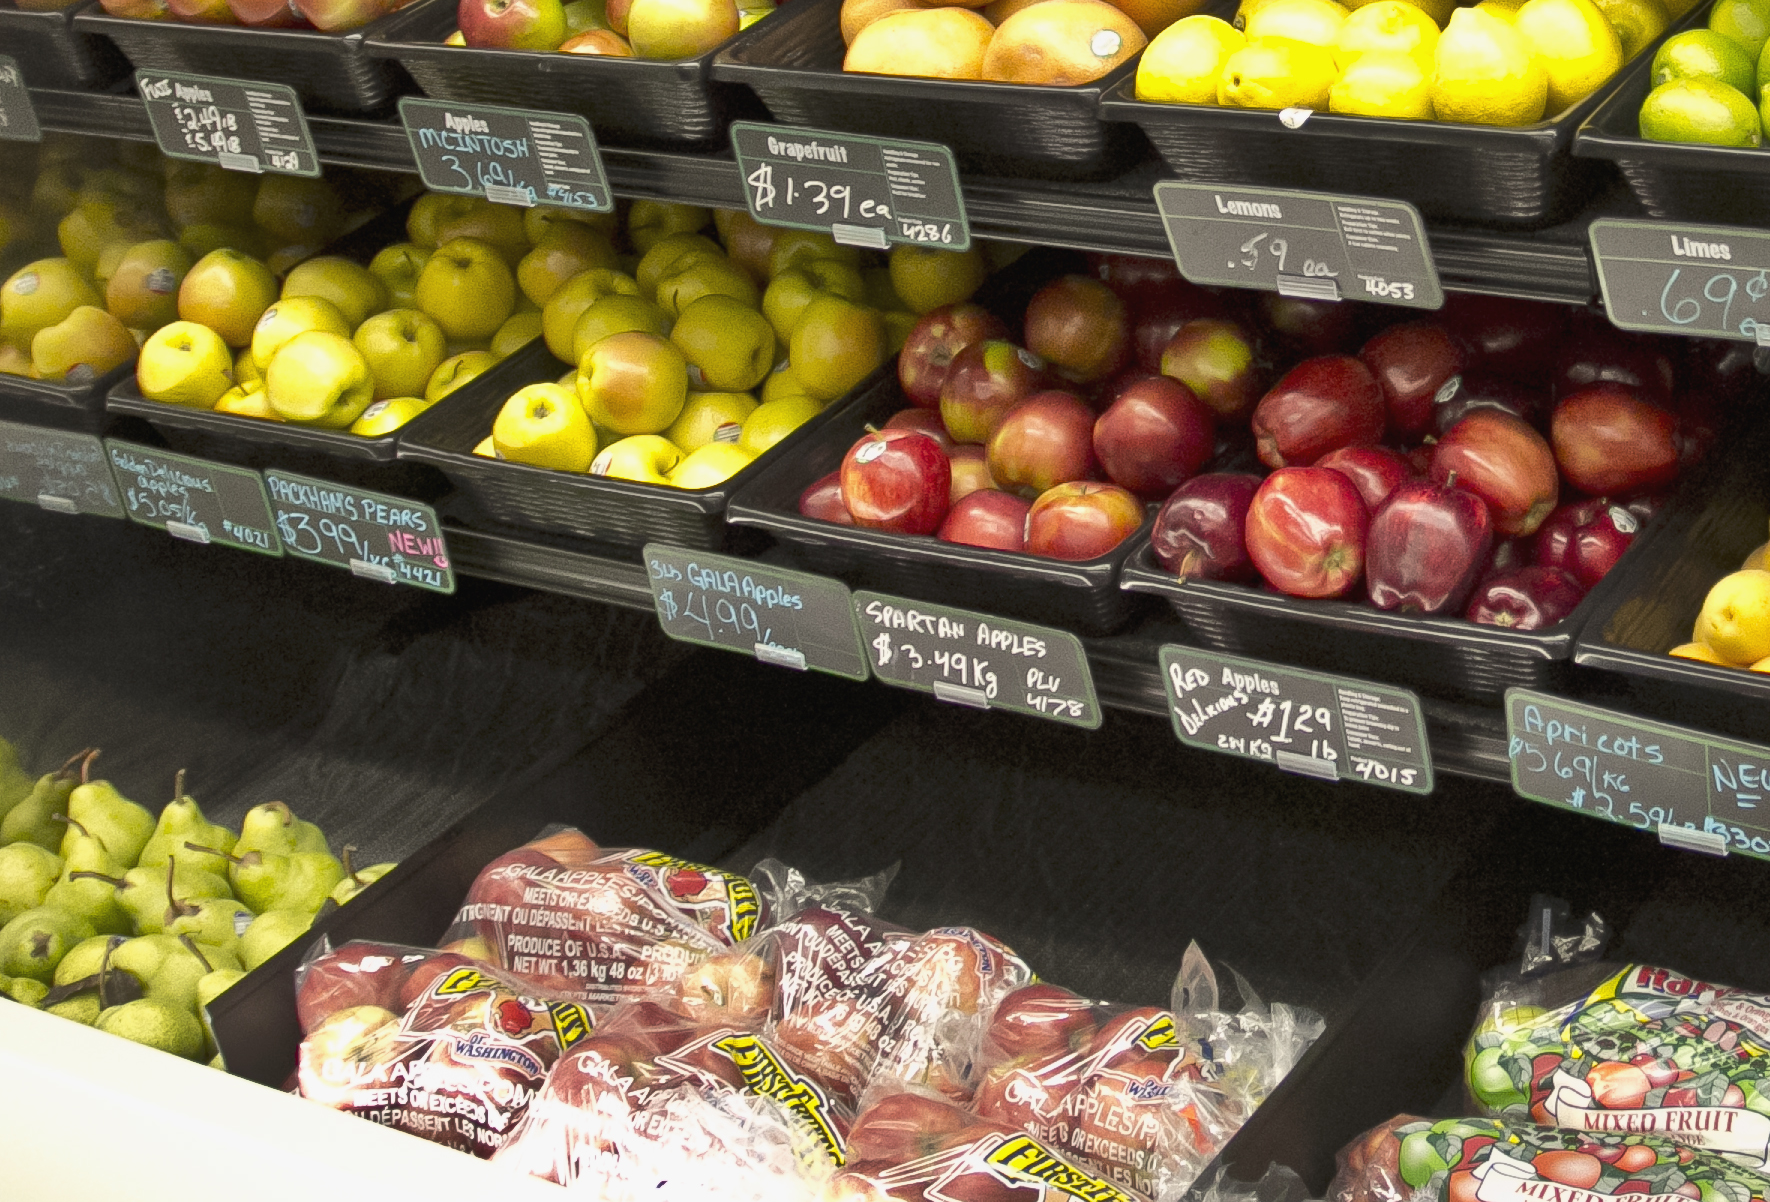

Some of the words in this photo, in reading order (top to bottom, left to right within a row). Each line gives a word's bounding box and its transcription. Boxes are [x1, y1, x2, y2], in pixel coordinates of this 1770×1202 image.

[445, 112, 489, 134] Apples
[768, 136, 848, 163] Grapefruit
[747, 162, 850, 219] $1.39
[860, 198, 893, 220] ea
[1215, 195, 1283, 219] Lemons
[902, 223, 952, 244] 4286
[1670, 234, 1732, 261] Limes
[1365, 278, 1415, 300] 4053
[361, 499, 428, 532] PEARS
[687, 562, 740, 597] GALA
[865, 600, 965, 640] SPARTAN
[976, 622, 1047, 659] APPLES
[1026, 667, 1061, 693] PLU
[1169, 662, 1211, 699] RED
[1221, 666, 1280, 696] Apples
[1026, 693, 1085, 717] 4178
[1355, 761, 1418, 785] 4015
[524, 887, 558, 905] MEETS
[559, 888, 577, 906] OR
[512, 907, 528, 926] OU
[507, 934, 562, 957] PRODUCE
[564, 936, 584, 958] OF
[826, 925, 865, 968] MEETS
[513, 956, 536, 974] NET
[537, 957, 558, 975] WT
[591, 959, 608, 983] kg
[609, 960, 625, 980] 48
[627, 964, 643, 981] oz
[456, 1041, 539, 1076] WASHINGTON
[353, 1087, 408, 1107] MEETS
[1584, 1111, 1657, 1133] MIXED
[1665, 1110, 1739, 1134] FRUIT
[1085, 1133, 1146, 1170] EXCEEDS
